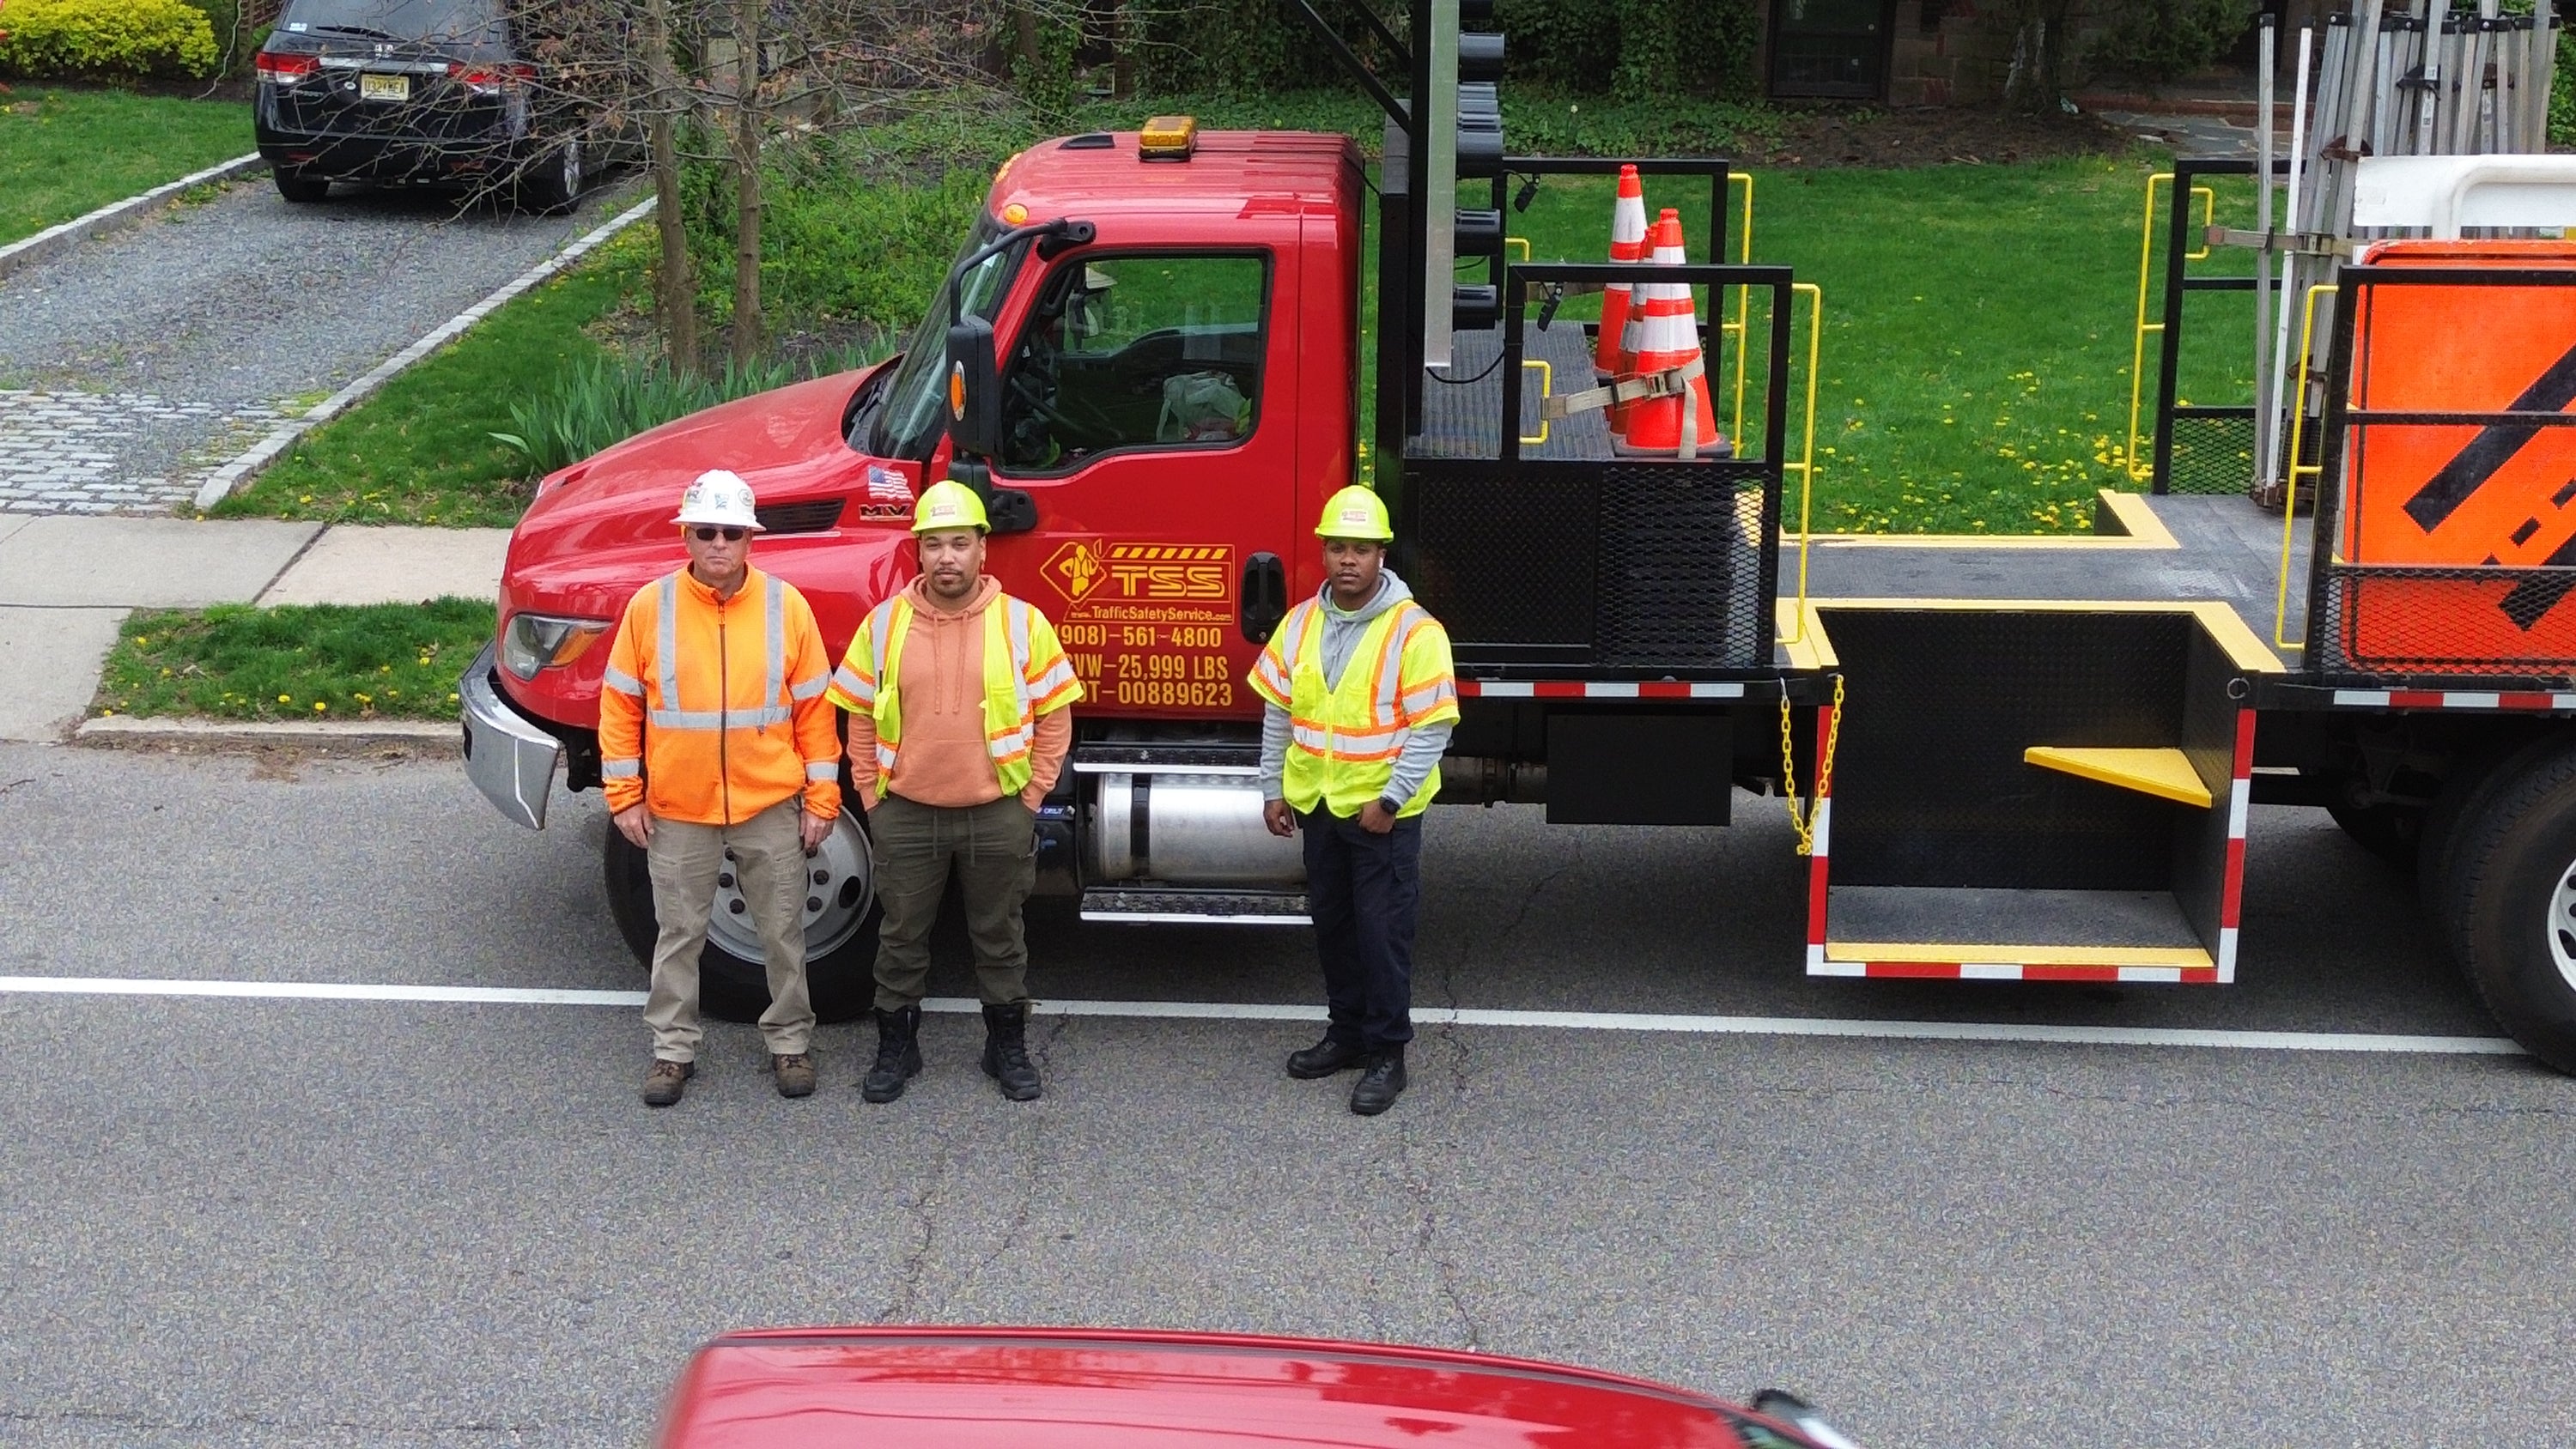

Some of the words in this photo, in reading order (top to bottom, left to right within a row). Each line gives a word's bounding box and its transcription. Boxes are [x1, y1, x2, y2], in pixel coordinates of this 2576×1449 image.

[859, 503, 911, 517] MV
[1111, 565, 1225, 598] TSS
[1054, 624, 1222, 647] (908)-561-4800
[1194, 655, 1229, 681] LBS
[1077, 680, 1233, 706] OT-00889623
